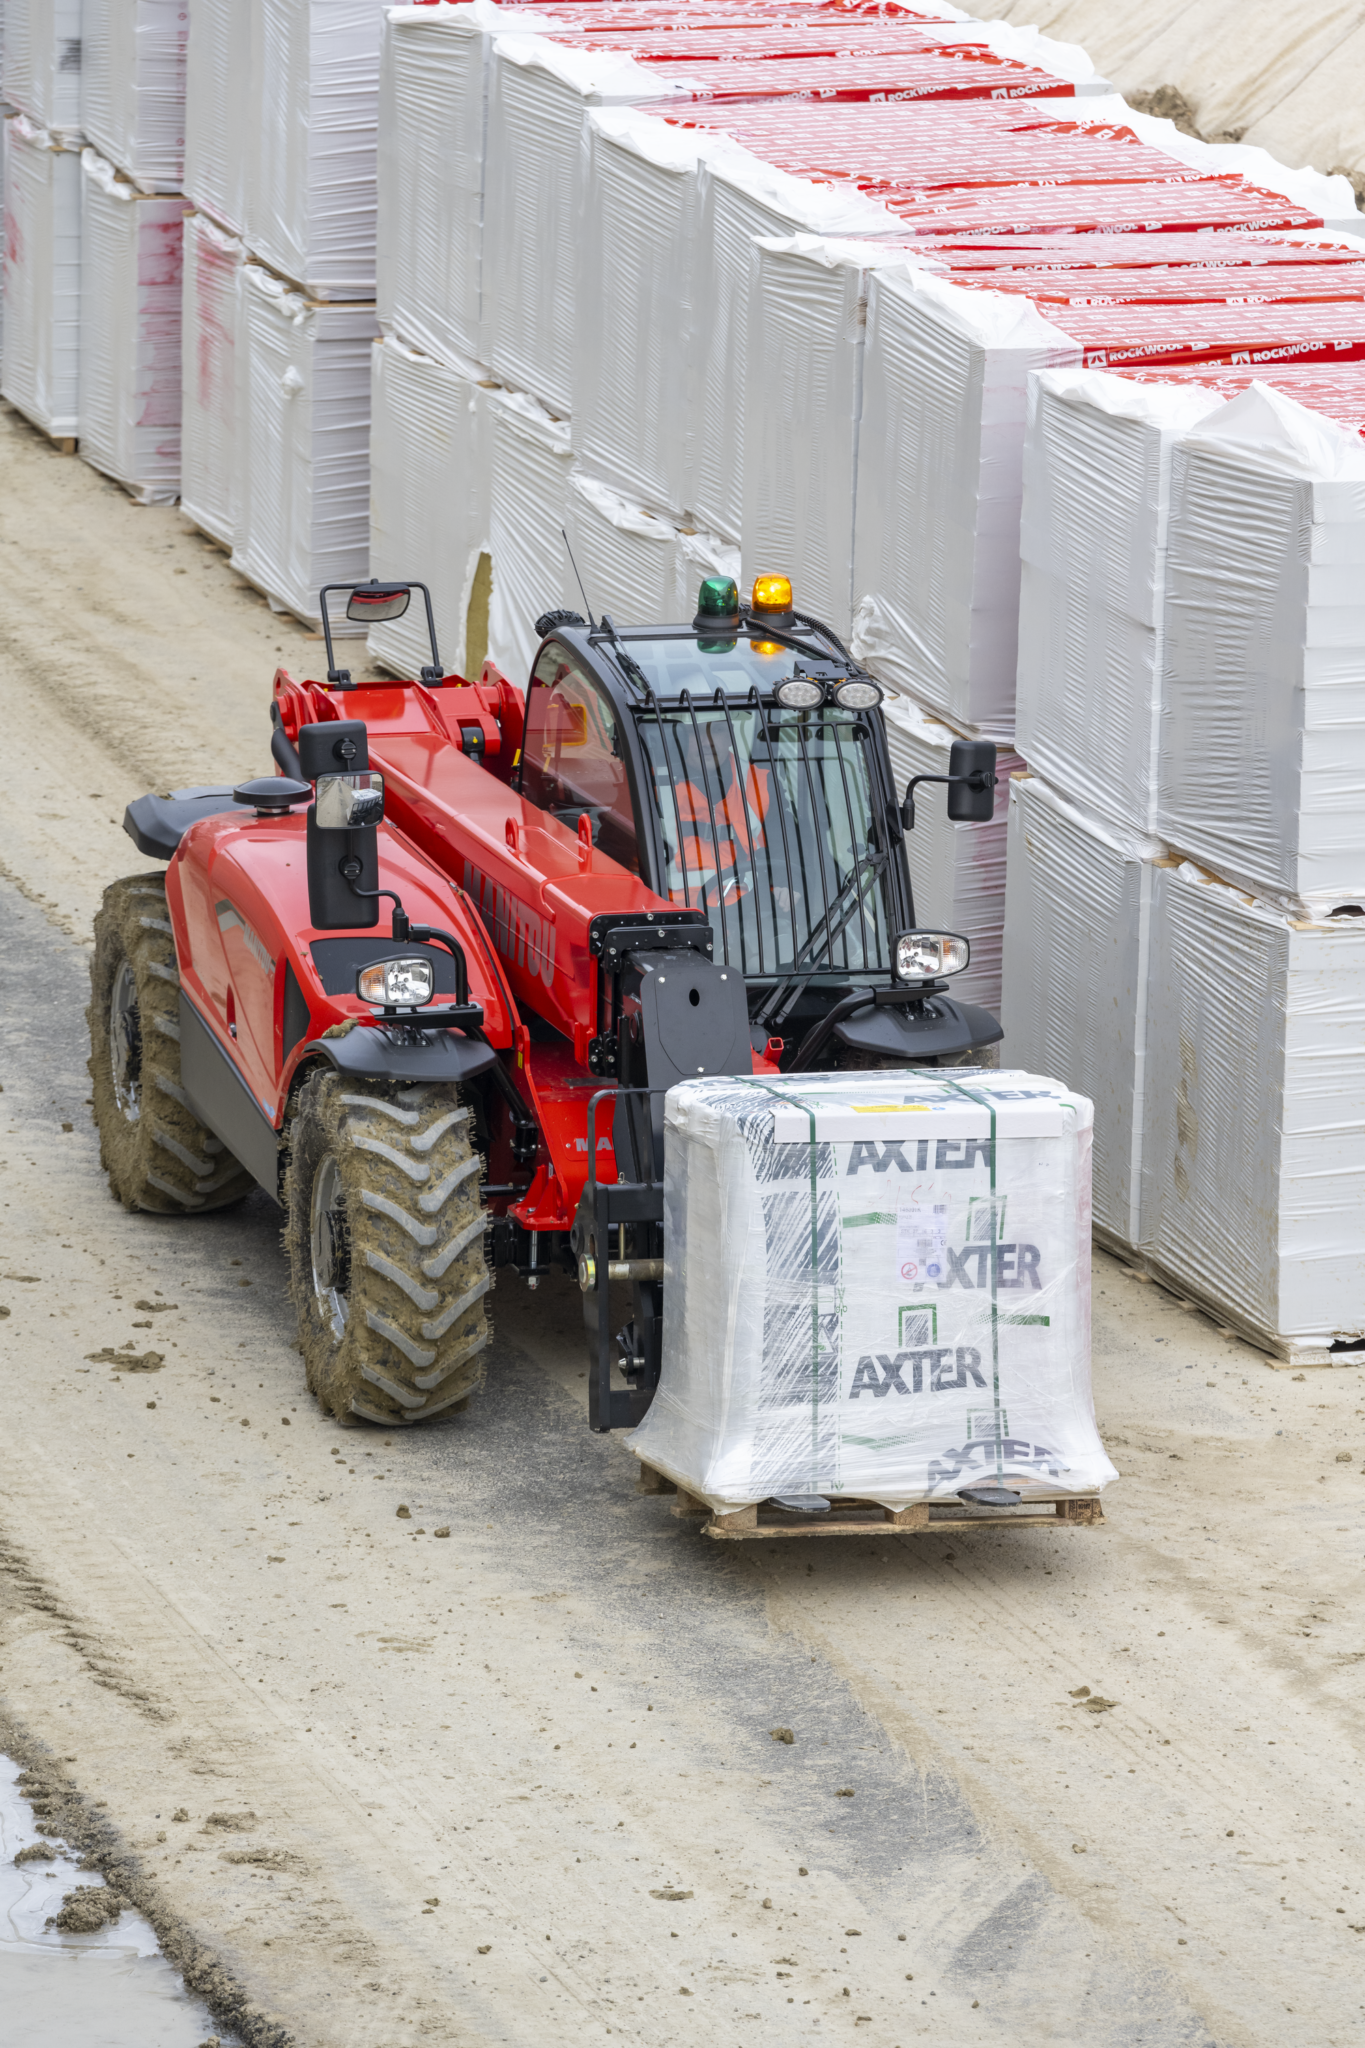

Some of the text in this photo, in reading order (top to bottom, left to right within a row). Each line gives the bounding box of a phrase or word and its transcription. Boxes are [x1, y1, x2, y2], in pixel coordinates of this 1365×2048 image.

[1109, 343, 1184, 362] ROCKWOOL
[1253, 341, 1327, 363] ROCKWOOL
[463, 860, 557, 988] MANITOU
[902, 1089, 1063, 1105] AXTER
[846, 1138, 993, 1176] AXTER
[848, 1346, 988, 1400] AXTER
[924, 1439, 1071, 1498] AXTER
